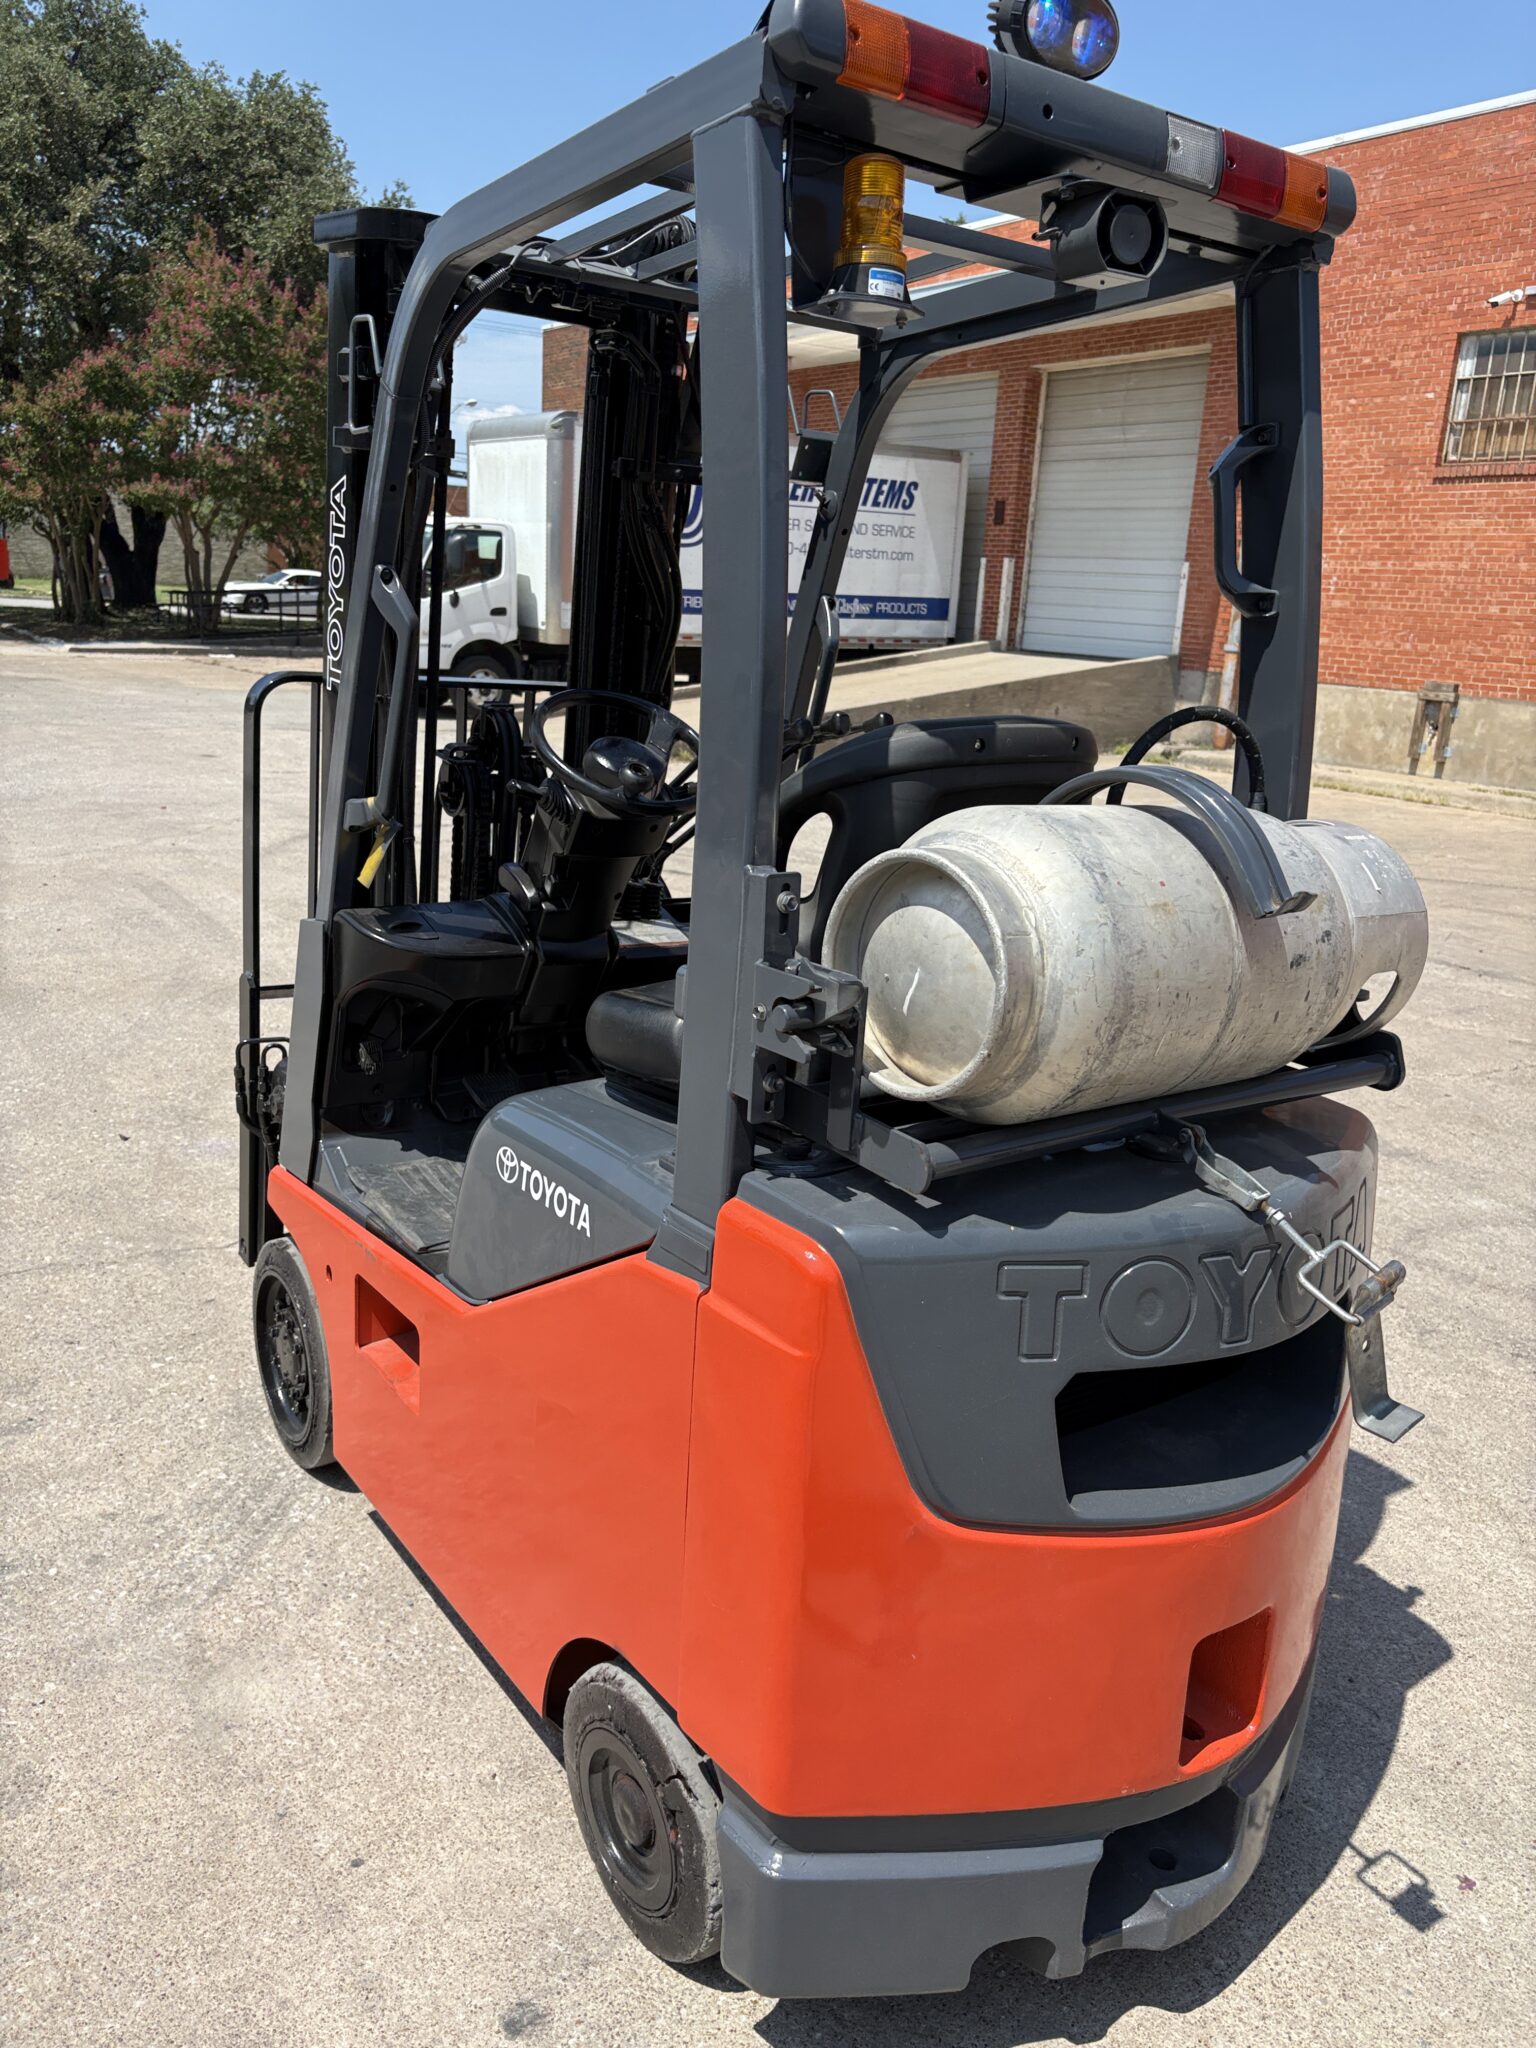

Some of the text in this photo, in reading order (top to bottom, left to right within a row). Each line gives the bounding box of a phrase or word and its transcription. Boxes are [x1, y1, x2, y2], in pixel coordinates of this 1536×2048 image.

[861, 478, 919, 511] TEMS
[853, 522, 916, 539] ND SERVICE
[326, 474, 347, 690] TOYOTA
[875, 601, 928, 615] PRODUCTS
[519, 1160, 591, 1238] TOYOTA
